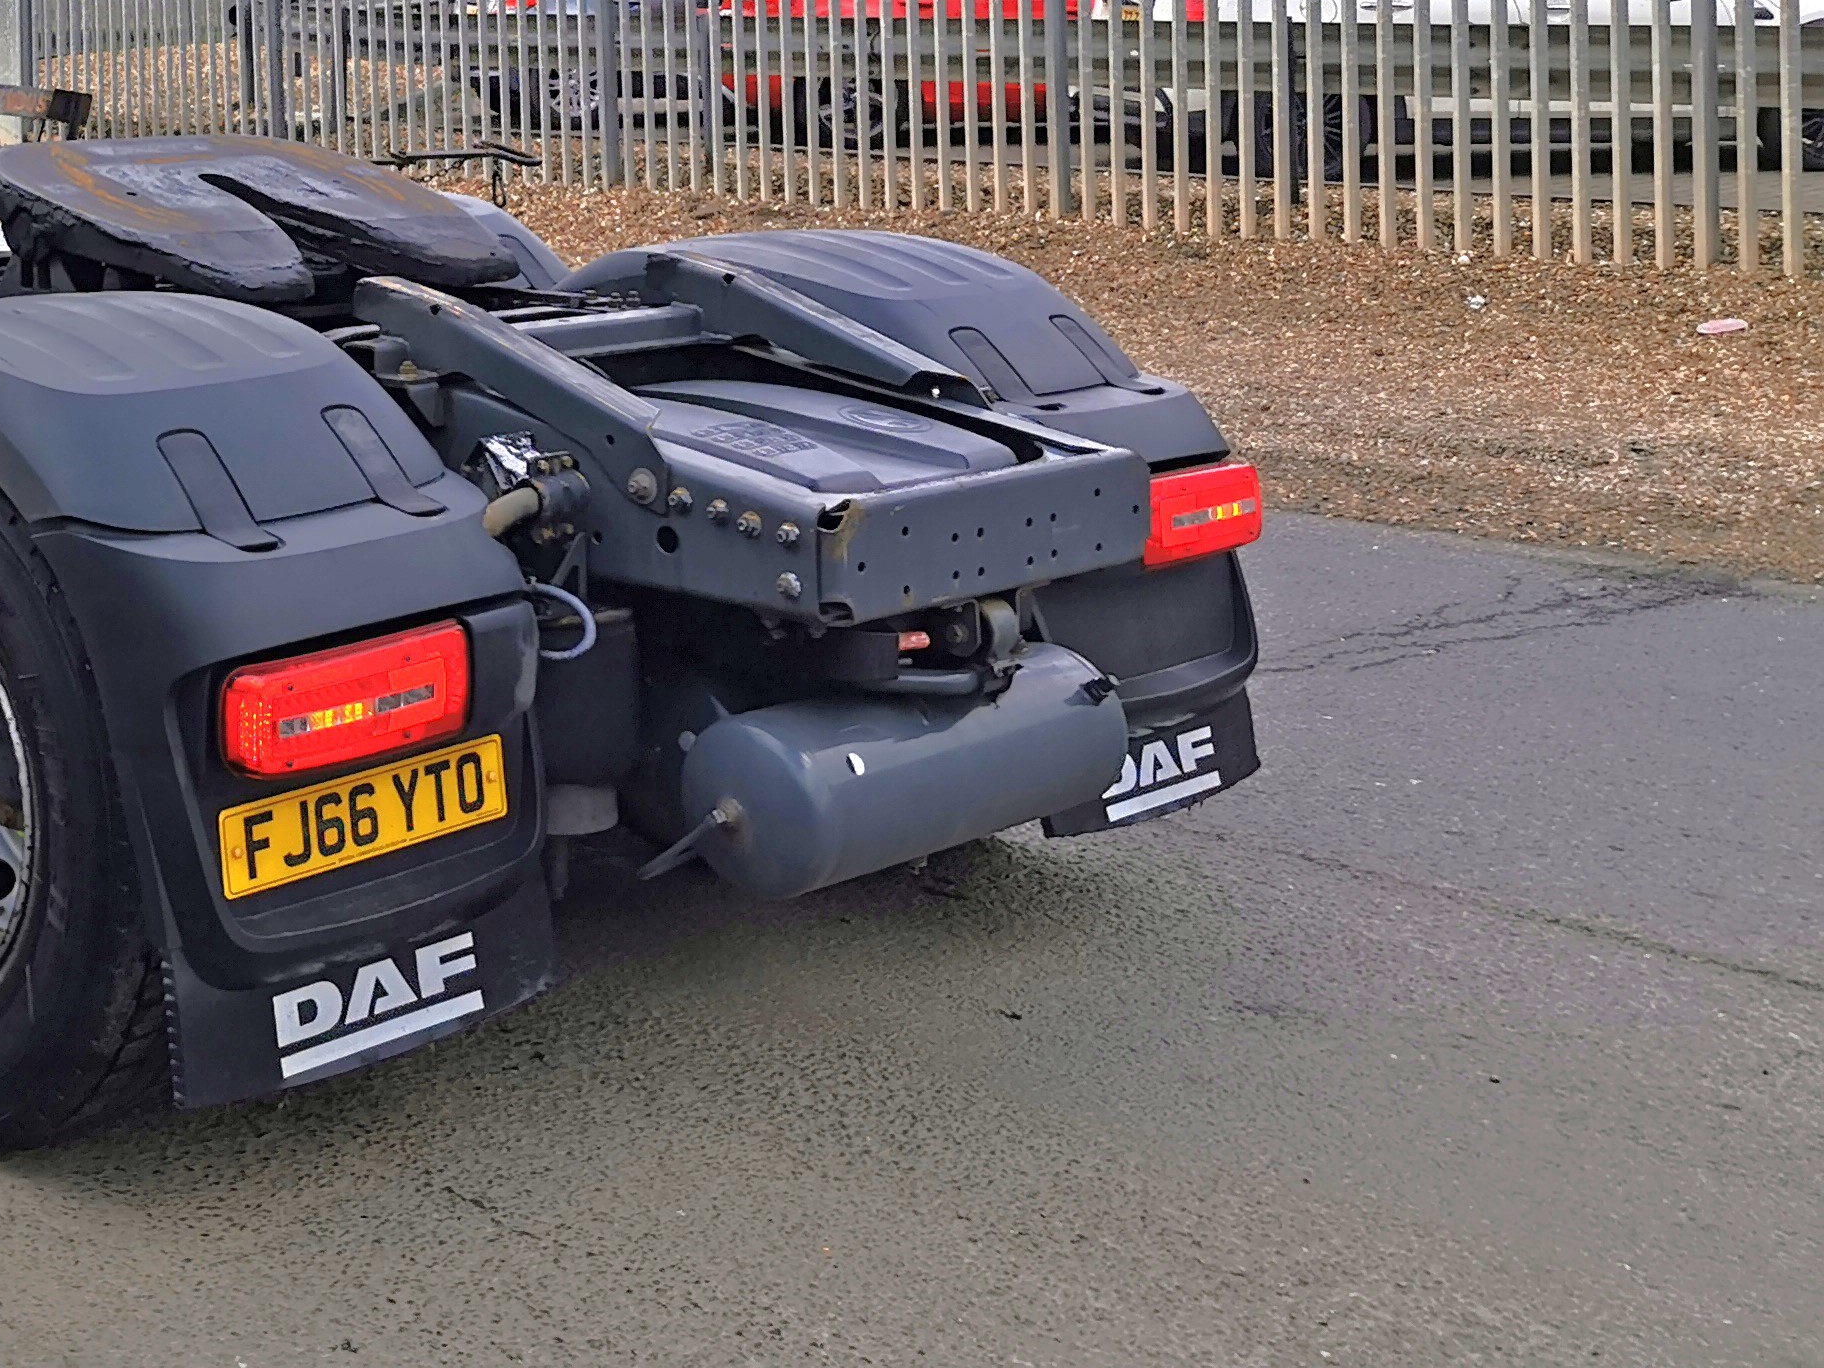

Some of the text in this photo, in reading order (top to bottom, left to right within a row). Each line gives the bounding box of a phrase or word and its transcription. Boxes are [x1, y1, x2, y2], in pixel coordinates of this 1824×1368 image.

[243, 751, 485, 881] FJ66 YTO
[272, 931, 477, 1049] DAF
